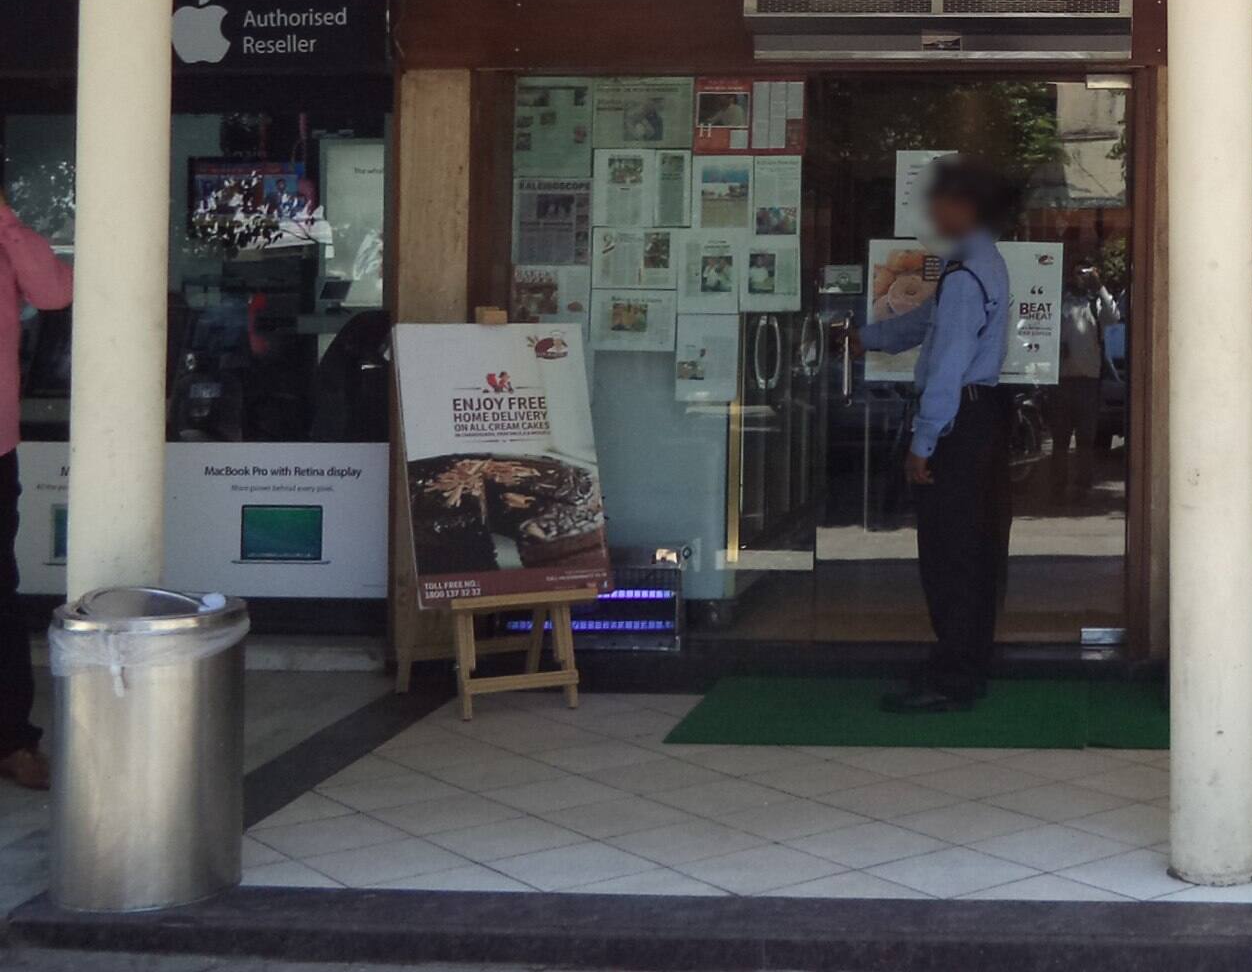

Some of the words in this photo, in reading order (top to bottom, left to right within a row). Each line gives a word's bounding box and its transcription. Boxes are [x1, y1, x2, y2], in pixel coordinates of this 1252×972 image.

[243, 7, 347, 27] Authorised
[243, 34, 317, 54] Reseller
[1019, 302, 1052, 316] BEAT
[452, 397, 505, 411] ENJOY
[507, 396, 547, 410] FREE
[453, 412, 490, 423] HOME
[491, 411, 548, 422] DELIVERY
[454, 423, 468, 432] ON
[469, 423, 488, 432] ALL
[488, 422, 520, 431] CREAM
[521, 421, 550, 430] CAKES
[204, 466, 250, 477] MacBook
[252, 466, 268, 477] Pro
[270, 466, 292, 476] with
[294, 466, 325, 477] Retina
[326, 466, 362, 479] display
